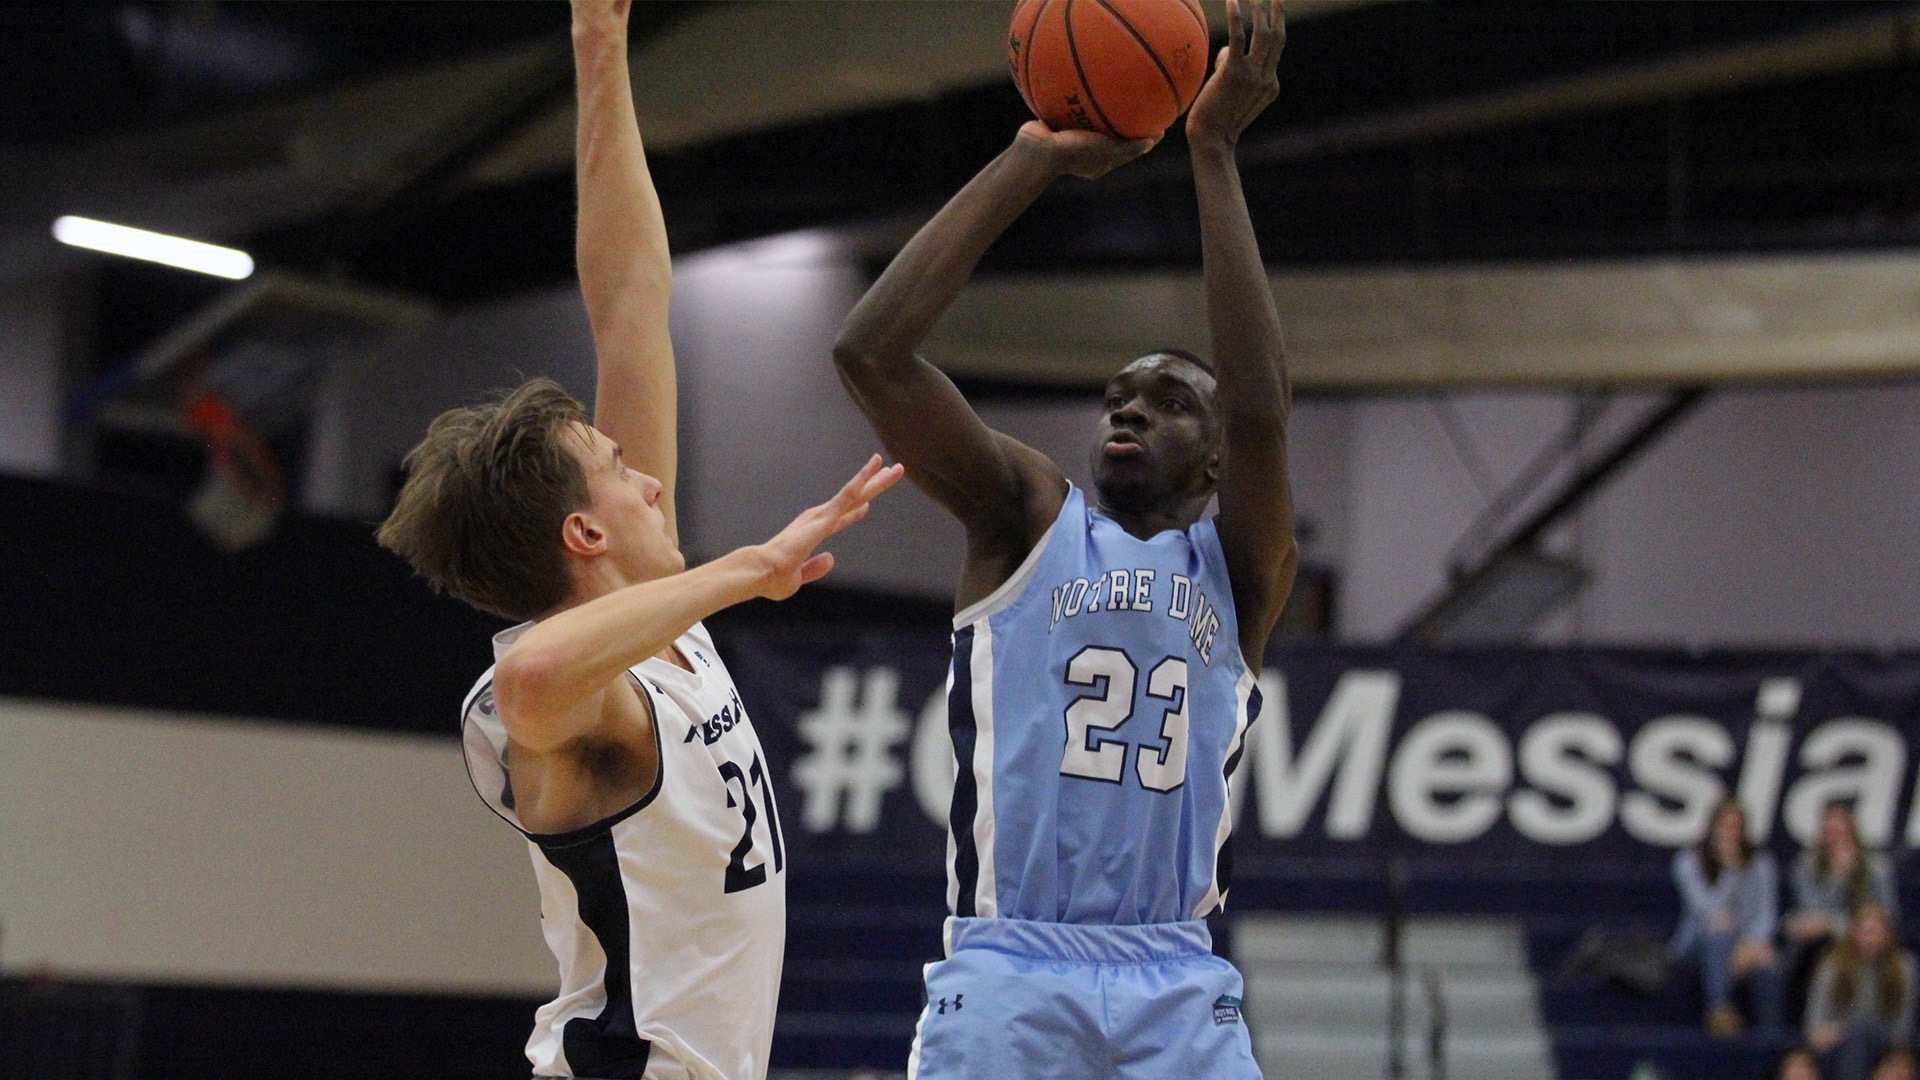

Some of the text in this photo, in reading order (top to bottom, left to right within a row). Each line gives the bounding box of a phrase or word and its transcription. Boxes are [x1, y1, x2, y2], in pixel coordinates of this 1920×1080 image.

[1049, 569, 1155, 634] NOTRE
[1059, 644, 1189, 795] 23
[717, 748, 783, 894] 21
